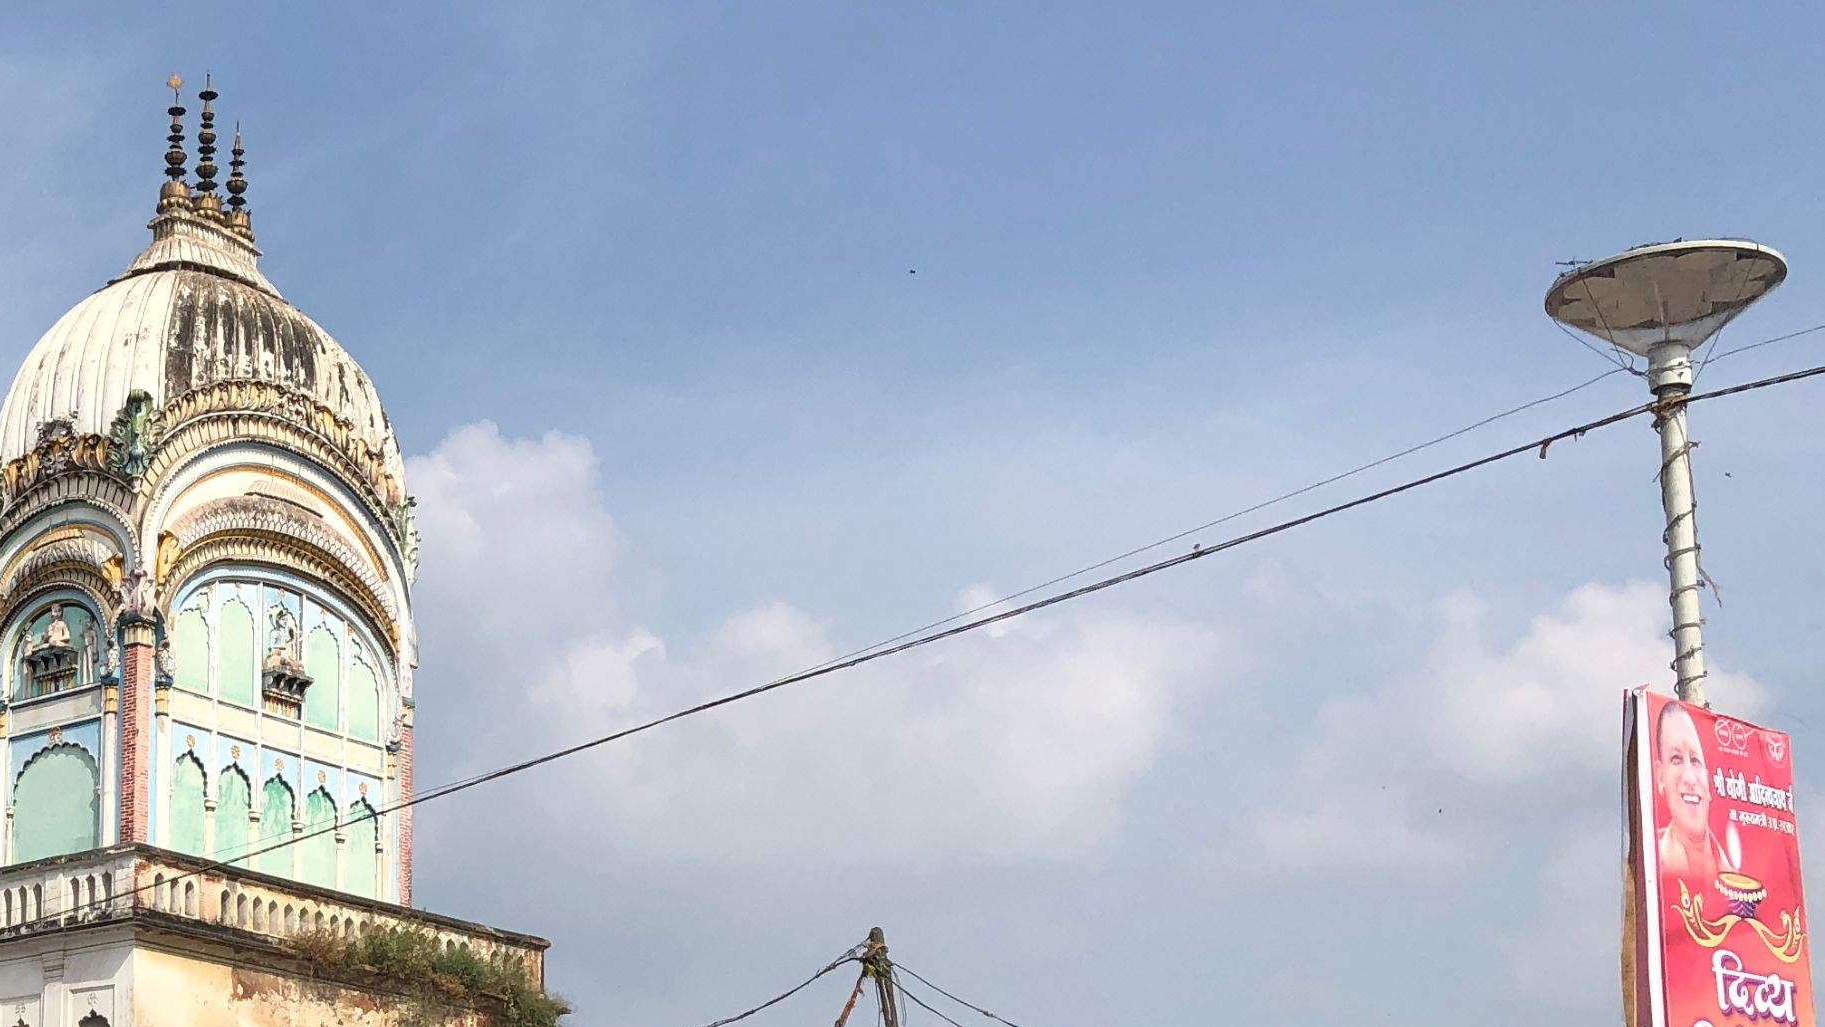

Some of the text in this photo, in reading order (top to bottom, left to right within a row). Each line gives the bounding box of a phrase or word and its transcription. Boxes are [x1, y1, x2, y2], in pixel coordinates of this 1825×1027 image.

[1714, 767, 1726, 797] श्री
[1725, 768, 1748, 801] योगी
[1712, 949, 1797, 1023] दिव्य
